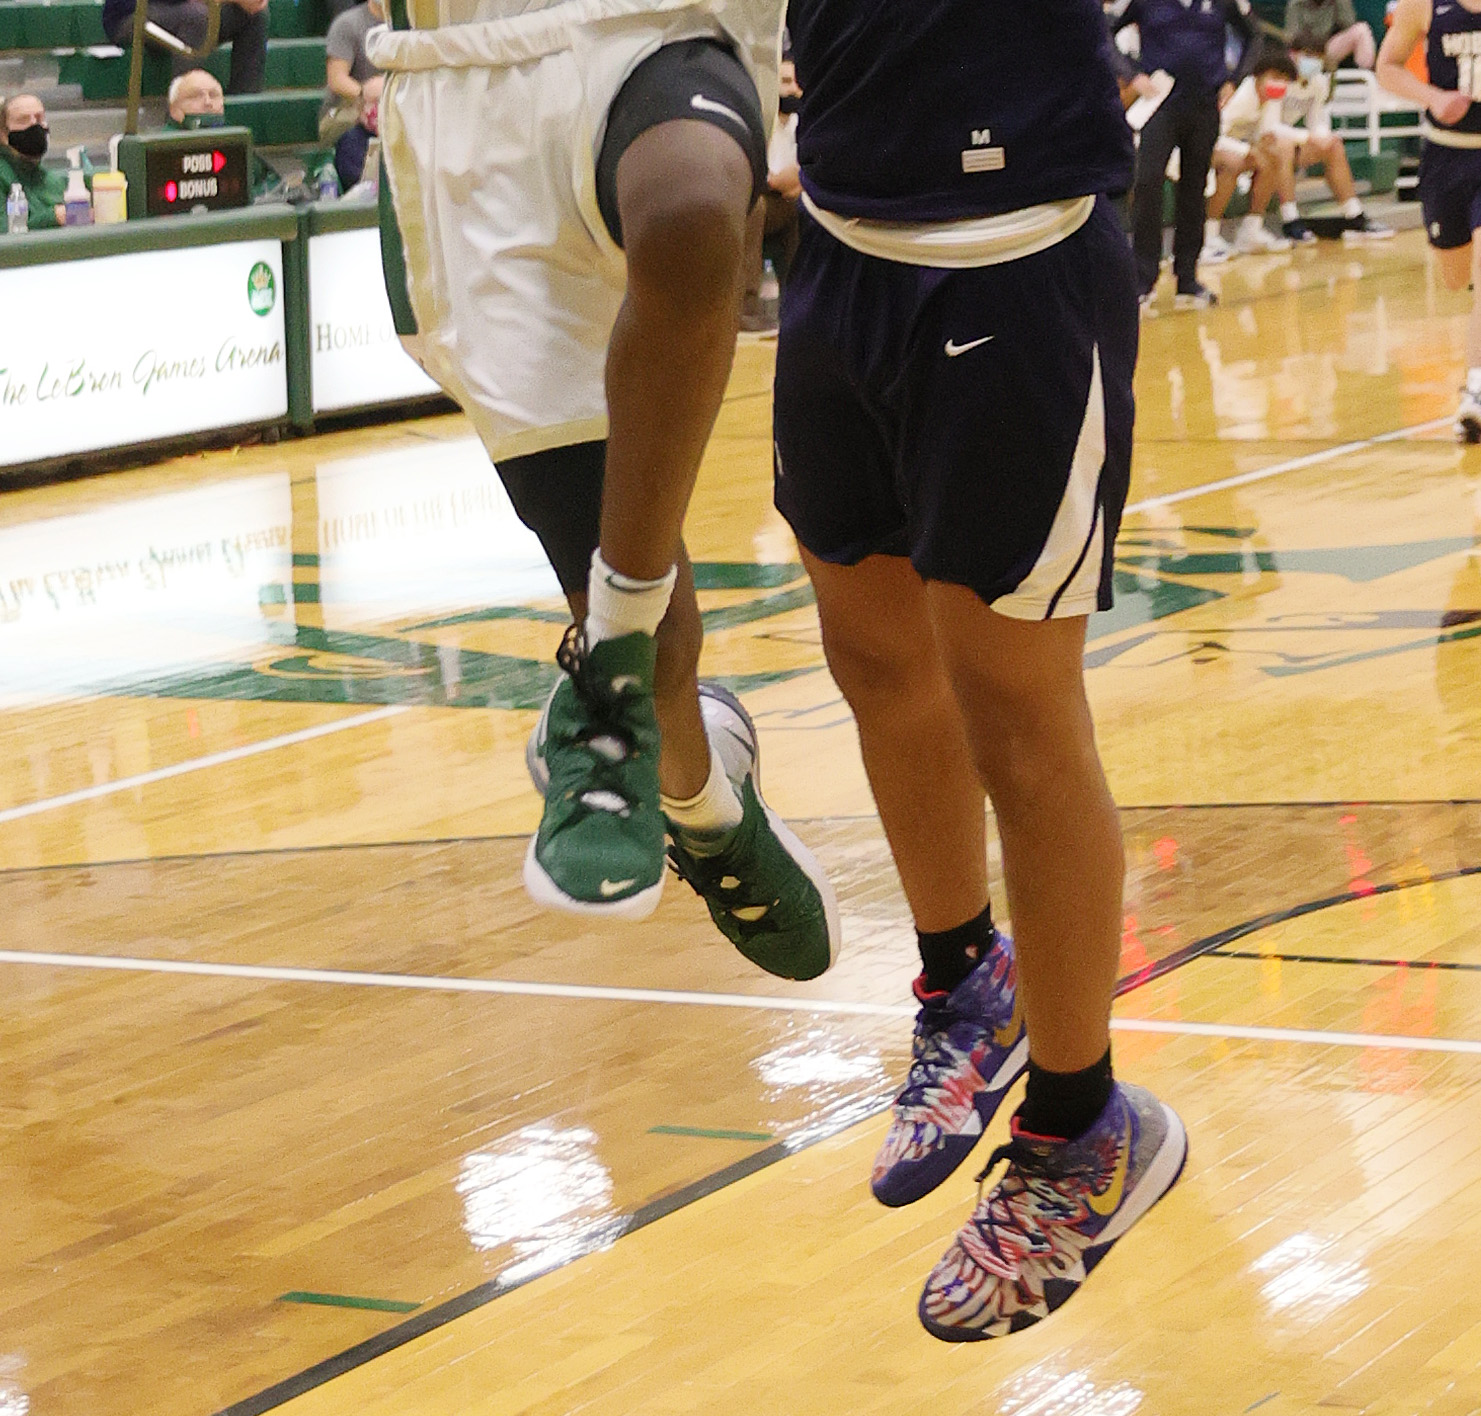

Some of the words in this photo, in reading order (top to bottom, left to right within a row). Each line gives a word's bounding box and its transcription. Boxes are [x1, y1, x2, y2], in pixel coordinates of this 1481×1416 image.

[179, 176, 218, 200] BONUS
[36, 357, 122, 404] LeBron
[133, 349, 206, 396] James
[215, 336, 283, 374] Arena
